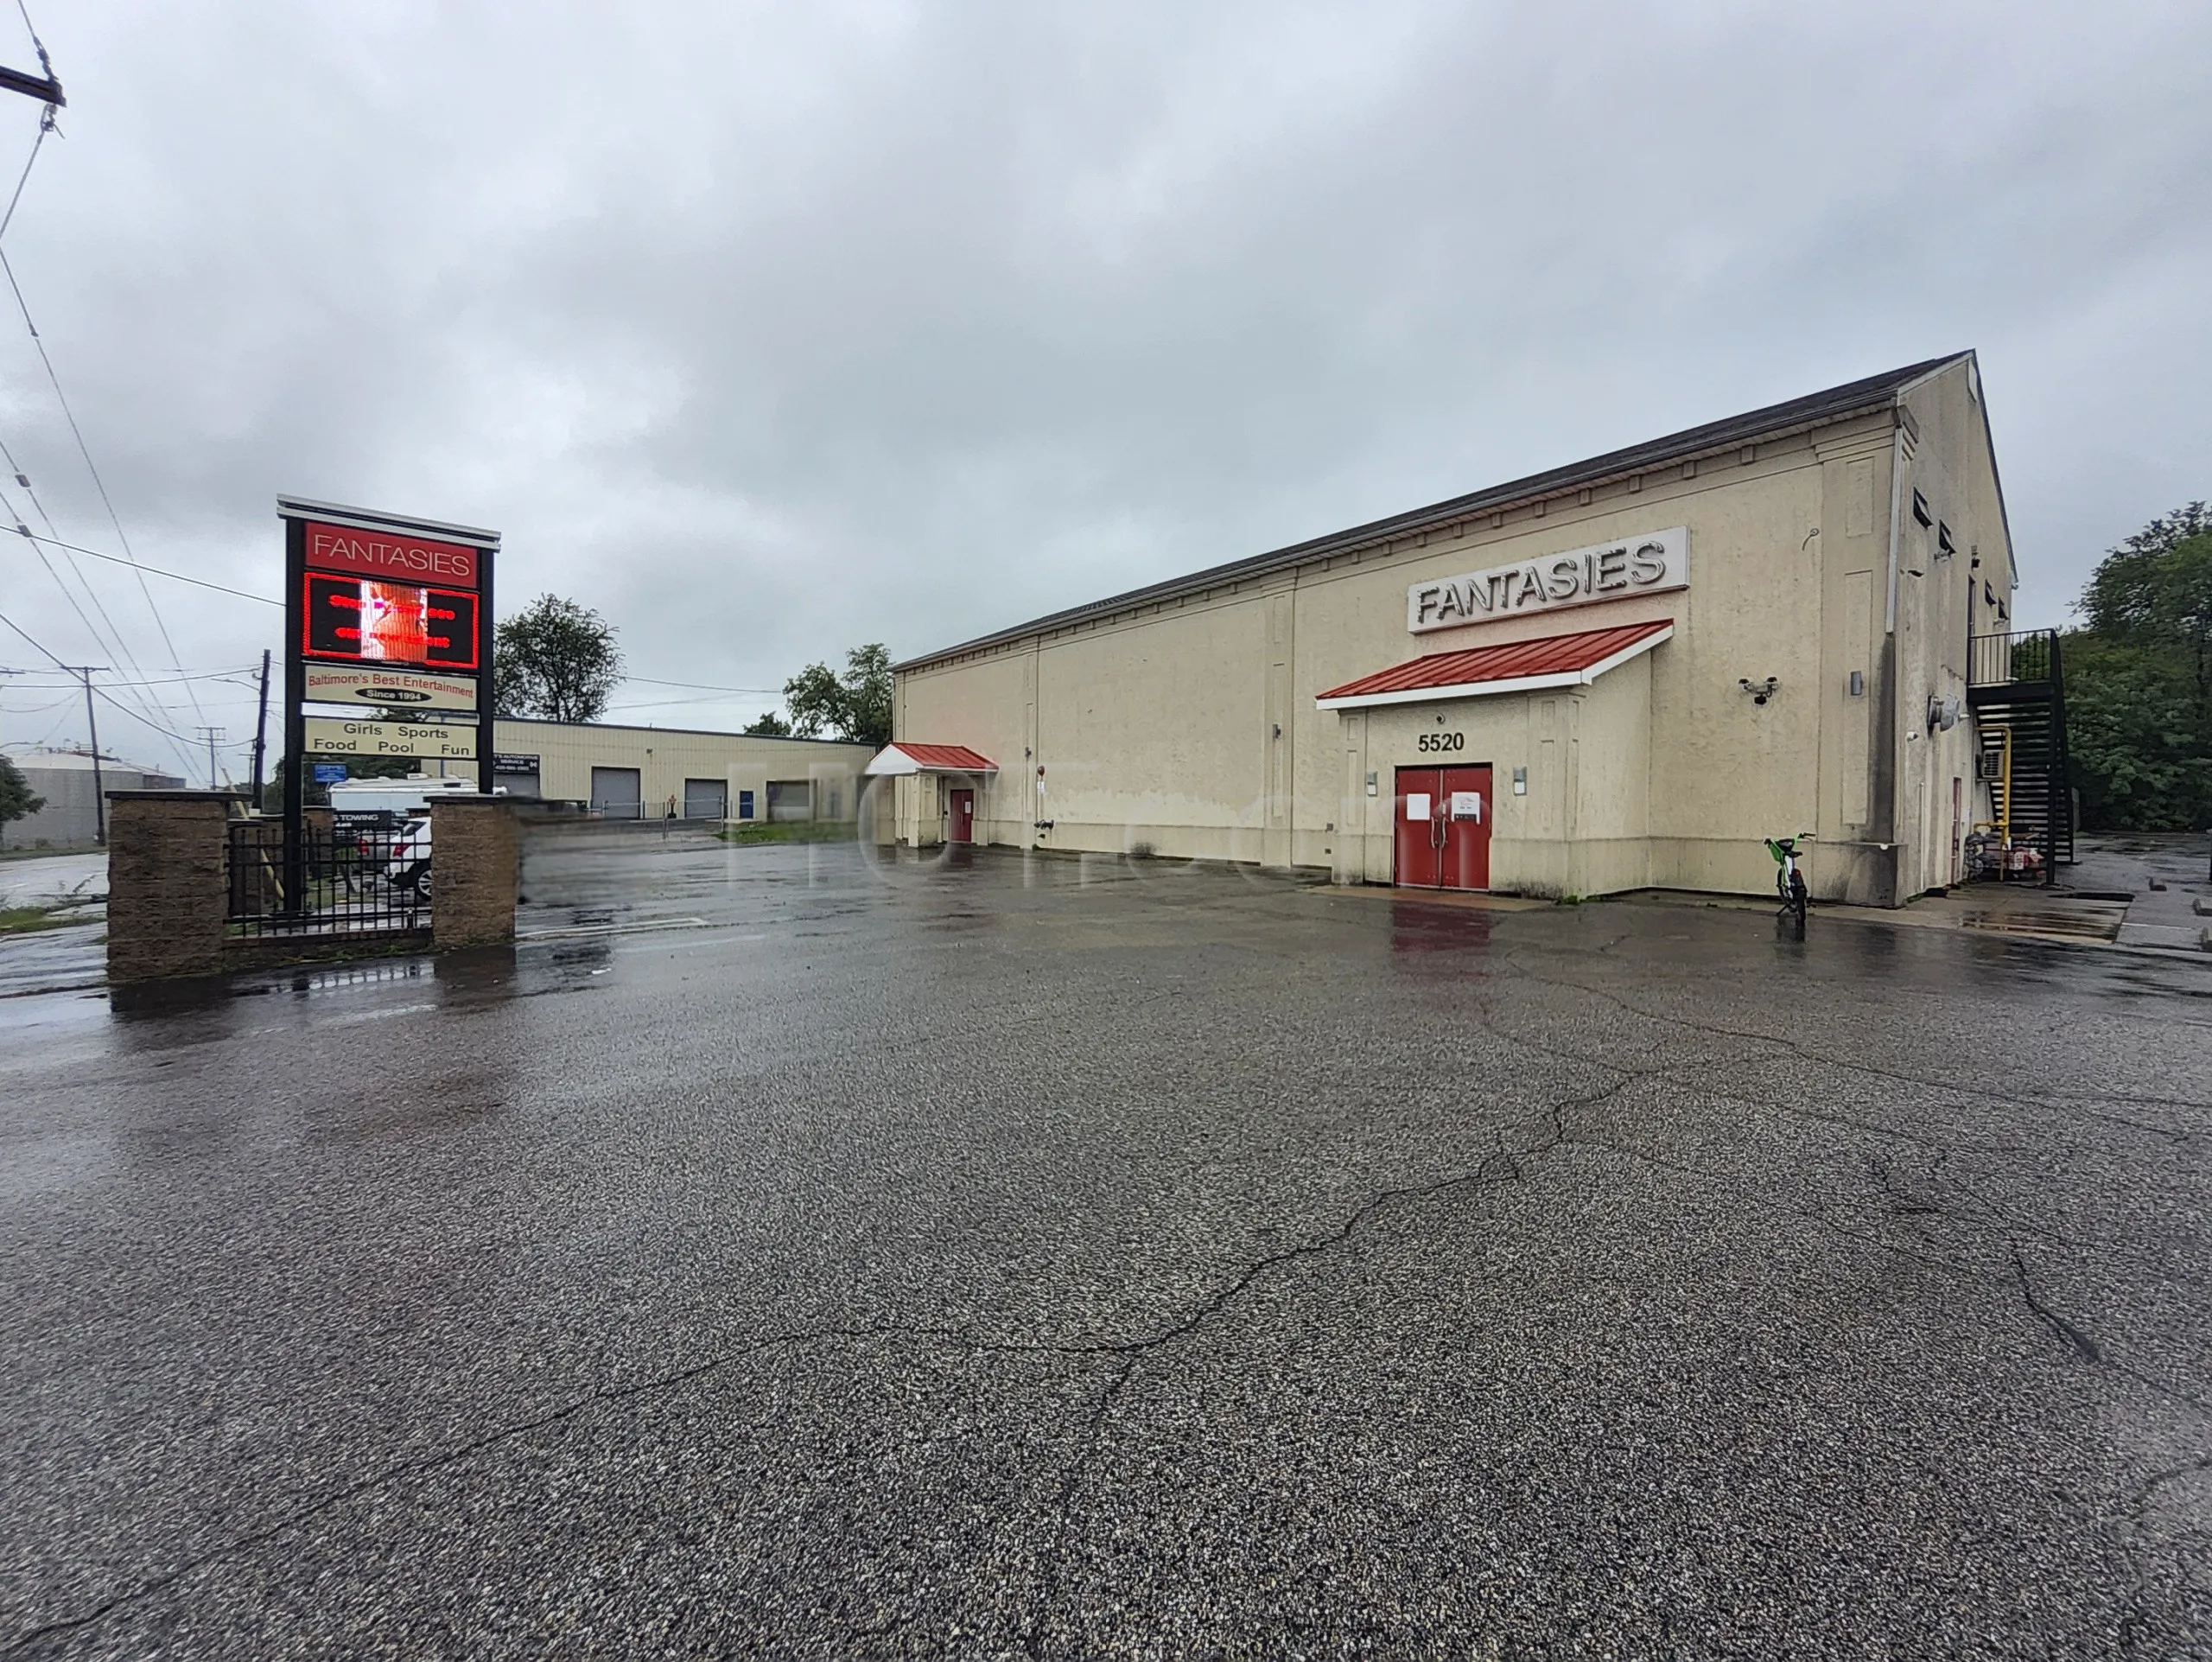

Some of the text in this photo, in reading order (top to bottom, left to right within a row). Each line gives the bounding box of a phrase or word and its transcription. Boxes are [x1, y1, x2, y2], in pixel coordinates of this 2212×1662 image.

[315, 534, 470, 576] FANTASIES
[1417, 540, 1666, 623] FANTASIES
[308, 673, 474, 698] Baltimore's Best Entertainment
[366, 690, 422, 701] Since 1994
[343, 723, 449, 740] Girls Sports
[314, 738, 470, 755] Food Pool Fun
[1418, 732, 1465, 753] 5520
